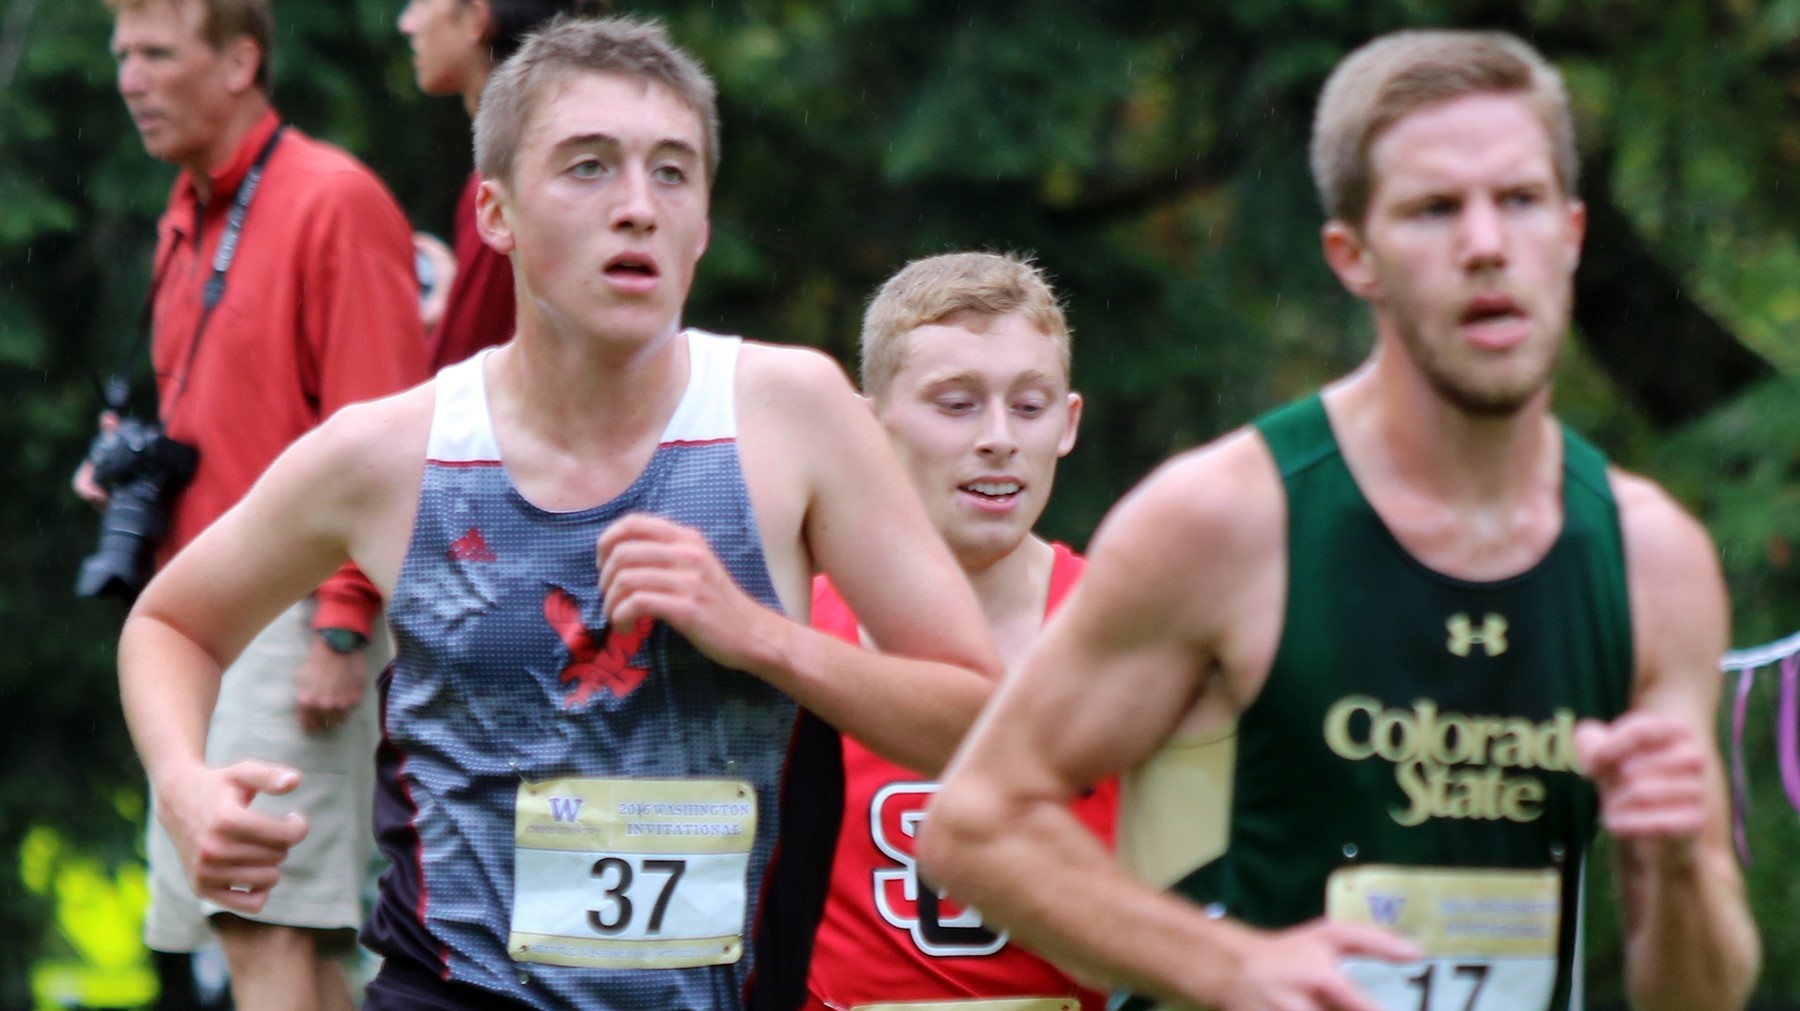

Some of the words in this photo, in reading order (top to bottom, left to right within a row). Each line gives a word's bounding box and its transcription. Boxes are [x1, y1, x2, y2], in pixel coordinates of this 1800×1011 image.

[1323, 694, 1582, 774] Colorad
[548, 797, 584, 823] W
[618, 803, 650, 817] 2016
[653, 803, 750, 817] WASHINGTON
[1387, 758, 1547, 828] State
[626, 823, 742, 837] INVITATIONAL
[585, 856, 687, 937] 37
[1407, 961, 1493, 1011] 17
